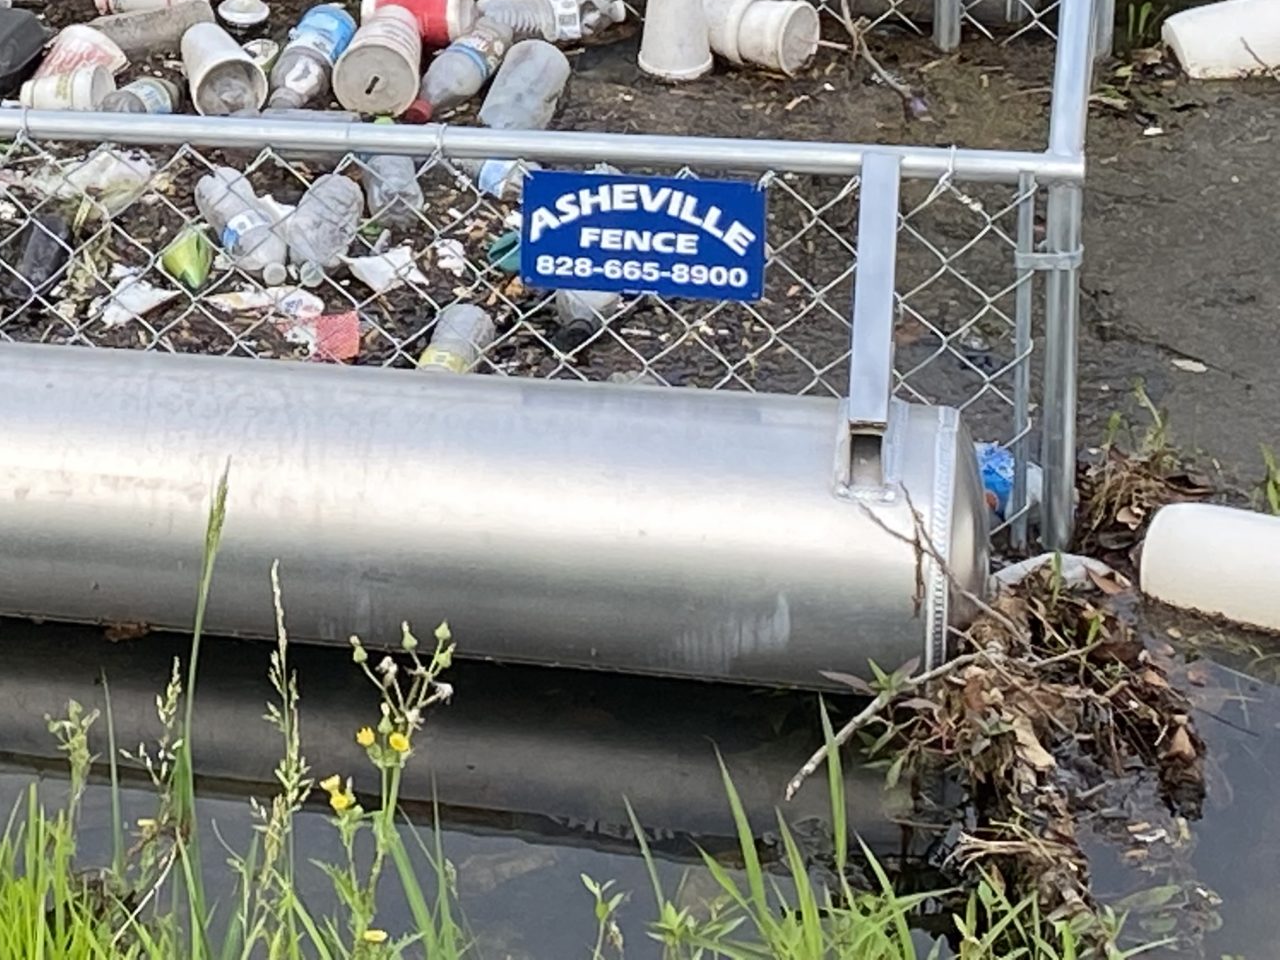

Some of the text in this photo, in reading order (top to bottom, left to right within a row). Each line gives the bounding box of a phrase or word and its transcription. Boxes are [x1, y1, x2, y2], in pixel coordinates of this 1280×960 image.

[530, 184, 756, 256] ASHEVILLE
[579, 227, 700, 255] FENCE
[536, 255, 748, 287] 828-665-8900
